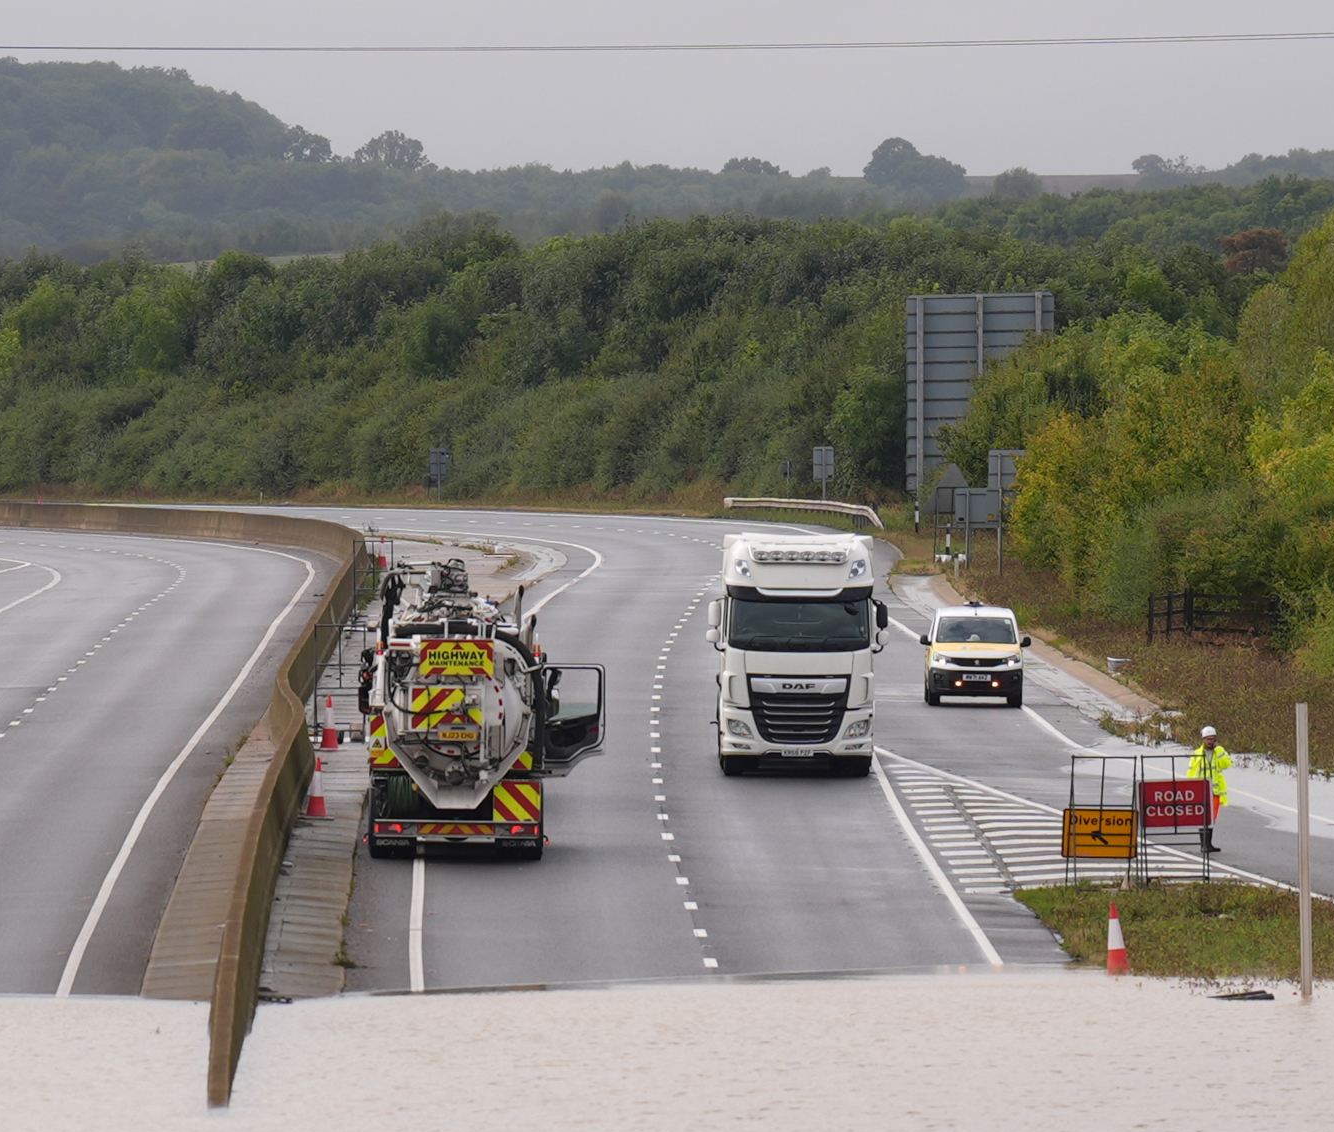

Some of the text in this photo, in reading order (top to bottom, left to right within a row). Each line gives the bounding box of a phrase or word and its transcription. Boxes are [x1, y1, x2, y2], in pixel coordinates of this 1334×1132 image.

[428, 651, 486, 660] HIGHWAY
[1154, 790, 1195, 802] ROAD
[1146, 804, 1205, 817] CLOSED
[1069, 814, 1133, 826] Diversion
